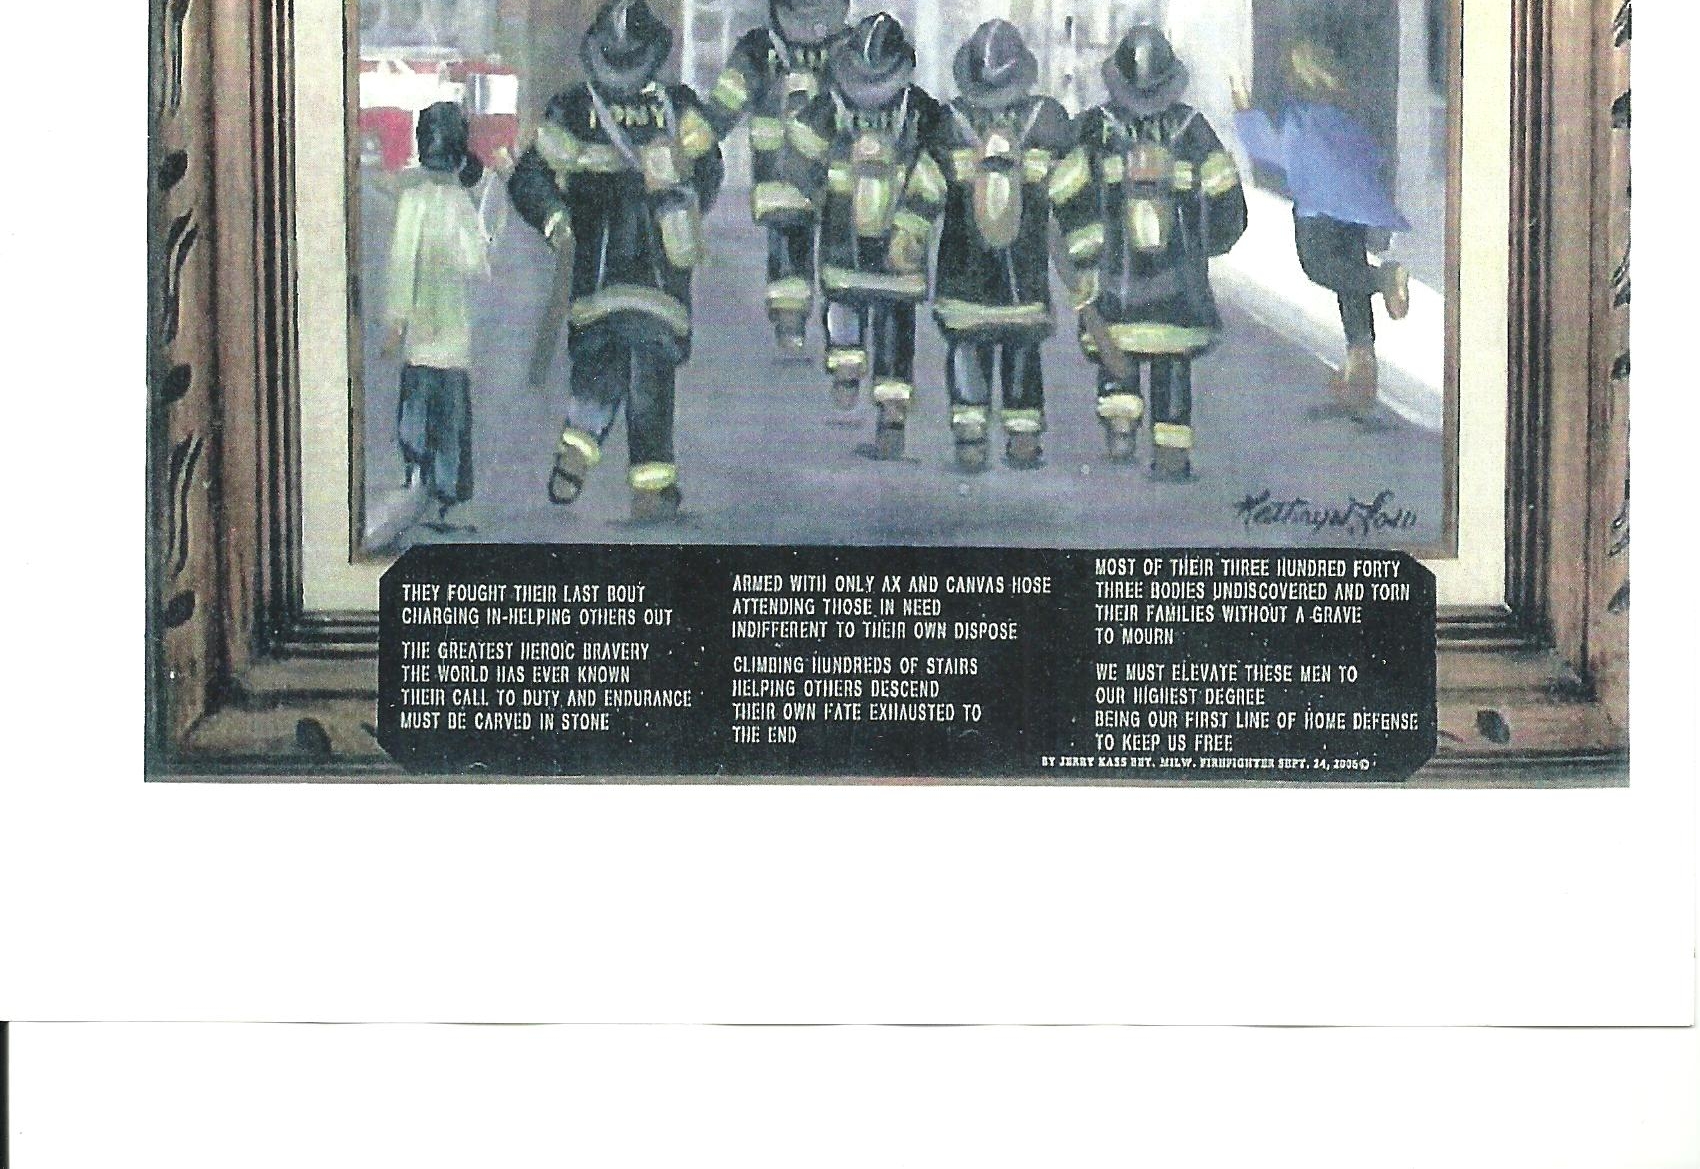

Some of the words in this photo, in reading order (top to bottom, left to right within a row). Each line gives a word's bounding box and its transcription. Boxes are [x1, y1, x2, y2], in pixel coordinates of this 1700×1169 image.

[1095, 557, 1137, 576] MOST
[1143, 557, 1163, 576] OF
[1168, 556, 1214, 577] THEIR
[1220, 558, 1270, 577] THREE
[1277, 556, 1347, 578] HUNDRED
[1353, 559, 1401, 579] FORTY
[401, 583, 441, 602] THEY
[446, 583, 507, 602] FOUGHT
[513, 584, 557, 603] THEIR
[563, 584, 600, 603] LAST
[607, 584, 646, 603] BOUT
[732, 574, 783, 593] ARMED
[789, 574, 827, 593] WITH
[834, 574, 875, 593] ONLY
[881, 575, 902, 593] AX
[908, 574, 939, 593] AND
[945, 575, 1005, 594] CANVAS
[1012, 575, 1052, 594] HOSE
[1095, 580, 1144, 599] THREE
[1150, 580, 1206, 600] BODIES
[1212, 580, 1328, 602] UNDISCOVERED
[1334, 582, 1365, 601] AND
[1370, 583, 1410, 602] TORN
[401, 606, 480, 625] CHARGING
[486, 607, 571, 626] IN-HELPING
[579, 607, 636, 626] OTHERS
[643, 608, 673, 626] OUT
[732, 597, 815, 616] ATTENDING
[822, 597, 873, 616] THOSE
[880, 597, 895, 616] IN
[903, 597, 941, 617] NEED
[1094, 603, 1139, 622] THEIR
[1146, 602, 1215, 623] FAMILIES
[1221, 602, 1288, 623] WITHOUT
[1295, 605, 1305, 624] A
[1312, 605, 1362, 624] GRAVE
[731, 620, 828, 639] INDIFFERENT
[835, 620, 856, 639] TO
[861, 619, 906, 640] THEIR
[913, 621, 947, 640] OWN
[954, 621, 1018, 640] DISPOSE
[1094, 626, 1115, 645] TO
[1121, 626, 1174, 645] MOURN
[401, 640, 430, 660] THE
[437, 641, 514, 662] GREATEST
[520, 641, 575, 661] HEROIC
[583, 642, 650, 661] BRAVERY
[401, 664, 430, 683] THE
[437, 664, 489, 683] WORLD
[496, 665, 525, 683] HAS
[532, 665, 570, 684] EVER
[577, 665, 630, 684] KNOWN
[733, 655, 804, 674] CLIMBING
[812, 655, 892, 675] HUNDREDS
[899, 656, 919, 676] OF
[926, 656, 978, 675] STAIRS
[1096, 662, 1118, 681] WE
[1125, 662, 1165, 682] MUST
[1171, 662, 1238, 683] ELEVATE
[1244, 663, 1293, 683] THESE
[1300, 664, 1331, 683] MEN
[1338, 664, 1358, 683] TO
[400, 688, 445, 706] THEIR
[452, 687, 489, 707] CALL
[496, 688, 516, 707] TO
[523, 689, 560, 707] DUTY
[566, 689, 597, 707] AND
[604, 689, 692, 708] ENDURANCE
[731, 678, 795, 698] HELPING
[803, 679, 863, 698] OTHERS
[871, 679, 940, 698] DESCEND
[1095, 686, 1126, 705] OUR
[1133, 685, 1198, 705] HIGHEST
[1205, 687, 1265, 706] DEGREE
[400, 711, 441, 730] MUST
[447, 711, 467, 730] BE
[474, 711, 532, 731] CARVED
[539, 712, 554, 731] IN
[561, 712, 610, 731] STONE
[731, 701, 776, 721] THEIR
[782, 702, 816, 721] OWN
[824, 702, 862, 721] FATE
[869, 702, 955, 722] EXHAUSTED
[962, 703, 982, 722] TO
[1094, 709, 1141, 728] BEING
[1147, 709, 1178, 729] OUR
[1185, 710, 1229, 729] FIRST
[1236, 710, 1270, 730] LINE
[1276, 711, 1297, 731] OF
[1304, 711, 1346, 731] HOME
[1352, 712, 1419, 731] DEFENSE
[731, 725, 761, 744] THE
[767, 725, 797, 744] END
[1094, 732, 1115, 751] TO
[1122, 733, 1161, 752] KEEP
[1167, 733, 1187, 752] US
[1194, 733, 1233, 753] FREE
[1041, 755, 1056, 767] BY
[1058, 756, 1095, 767] JERRY
[1097, 756, 1128, 768] KASS
[1277, 757, 1311, 769] SEPT.
